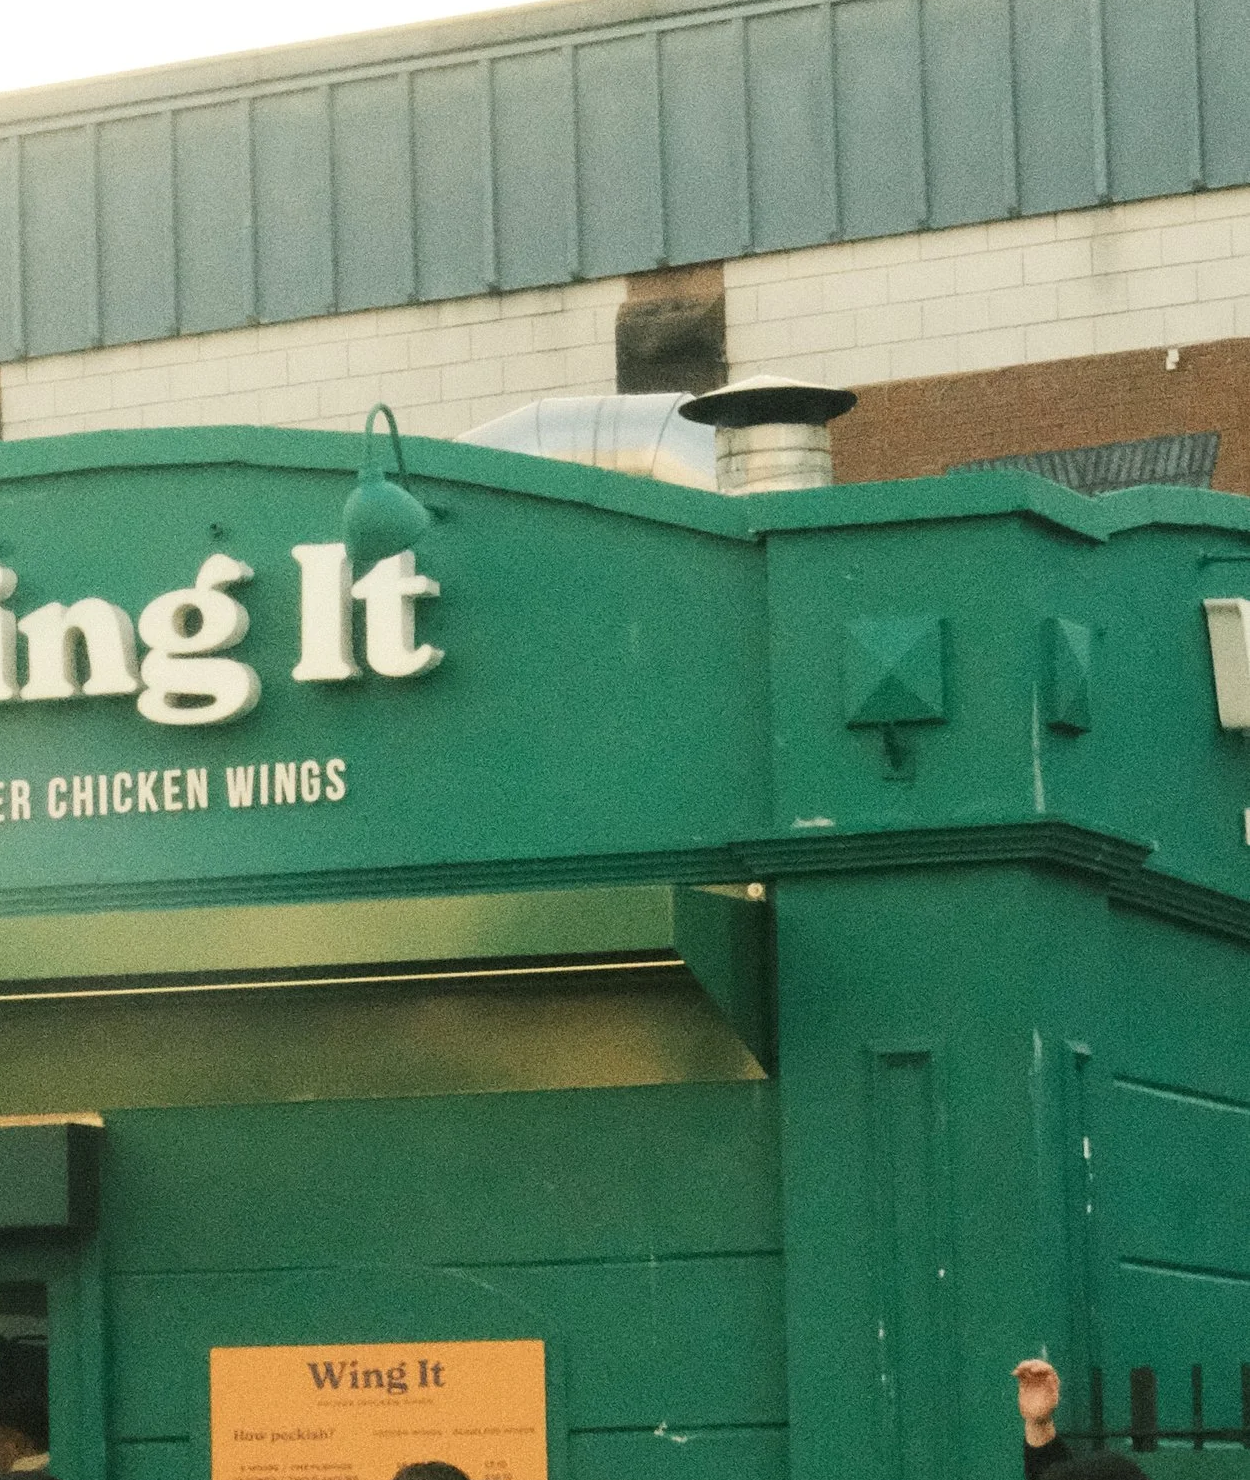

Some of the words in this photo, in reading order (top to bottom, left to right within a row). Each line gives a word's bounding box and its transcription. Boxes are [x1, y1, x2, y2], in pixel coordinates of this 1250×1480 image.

[291, 542, 446, 681] It
[47, 767, 209, 819] CHICKEN
[226, 758, 347, 810] WINGS
[306, 1359, 409, 1396] Wing
[417, 1358, 446, 1388] It
[233, 1429, 266, 1442] How
